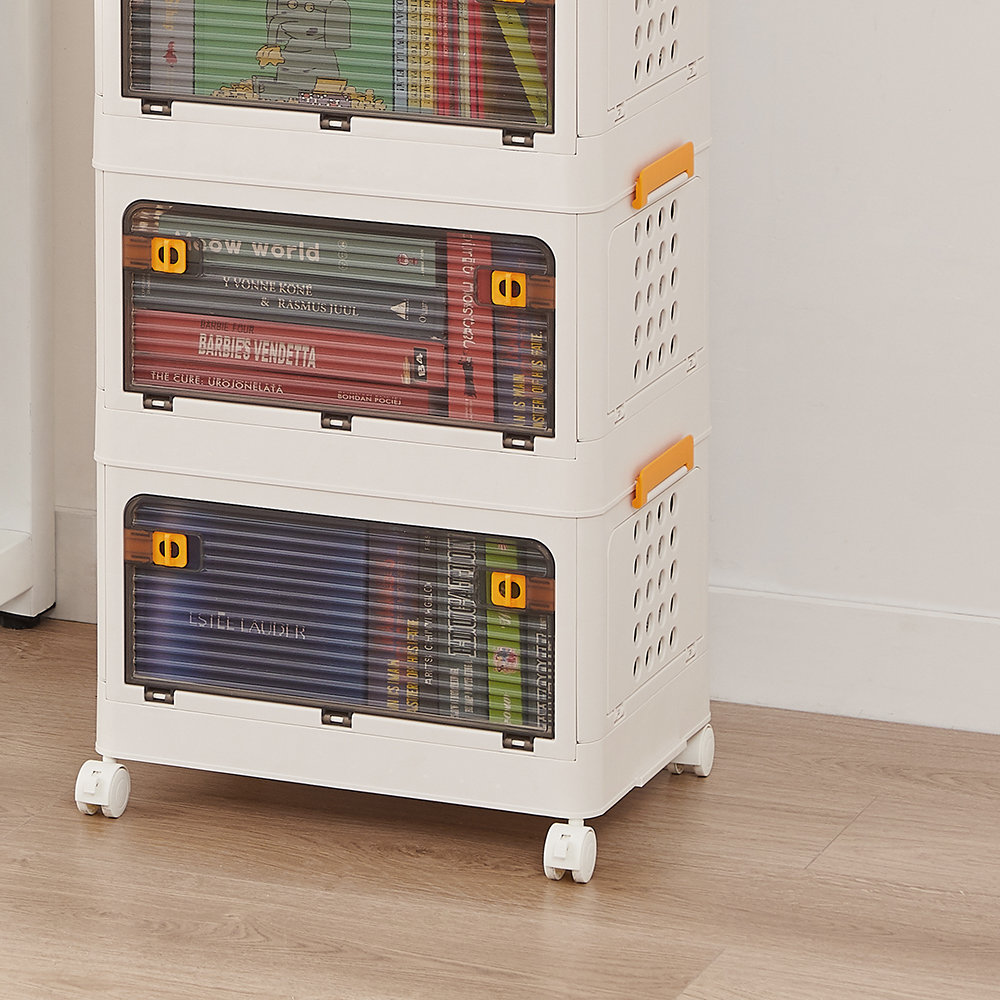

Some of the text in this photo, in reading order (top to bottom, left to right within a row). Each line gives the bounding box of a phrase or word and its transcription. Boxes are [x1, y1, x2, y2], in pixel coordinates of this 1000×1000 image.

[252, 242, 320, 262] world
[260, 297, 359, 316] & RASMUS JUUL
[200, 320, 255, 334] BARBIE FOUR
[254, 339, 316, 368] VENDETTA
[151, 371, 170, 382] THE
[337, 392, 372, 402] BOHDAN
